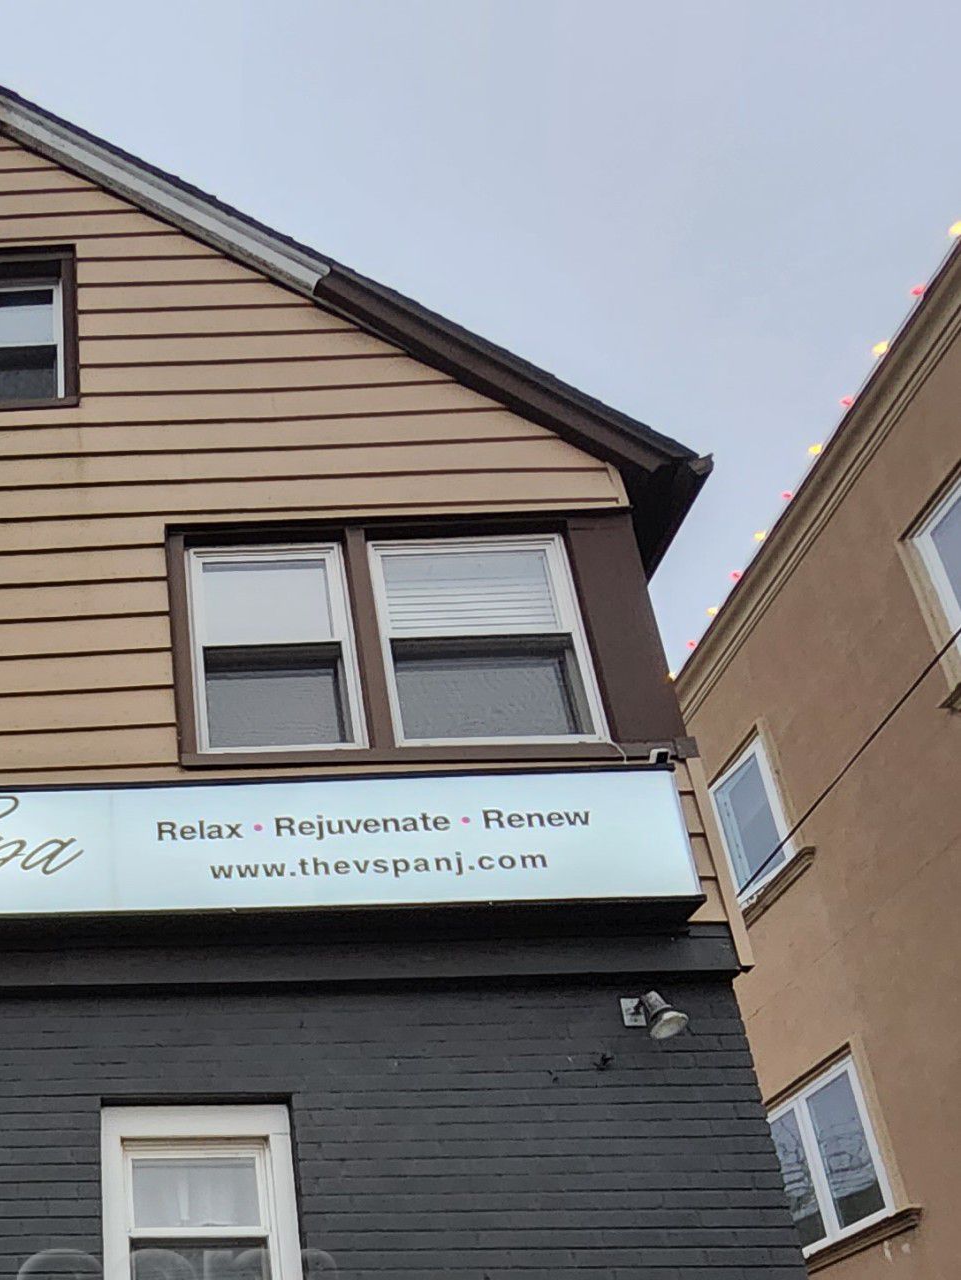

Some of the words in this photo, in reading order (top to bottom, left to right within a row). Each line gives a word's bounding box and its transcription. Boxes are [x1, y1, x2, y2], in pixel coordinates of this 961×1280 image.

[156, 819, 245, 843] Relax
[274, 811, 453, 843] Rejuvenate
[482, 806, 592, 831] Renew
[209, 850, 550, 881] www.thevspanj.com
